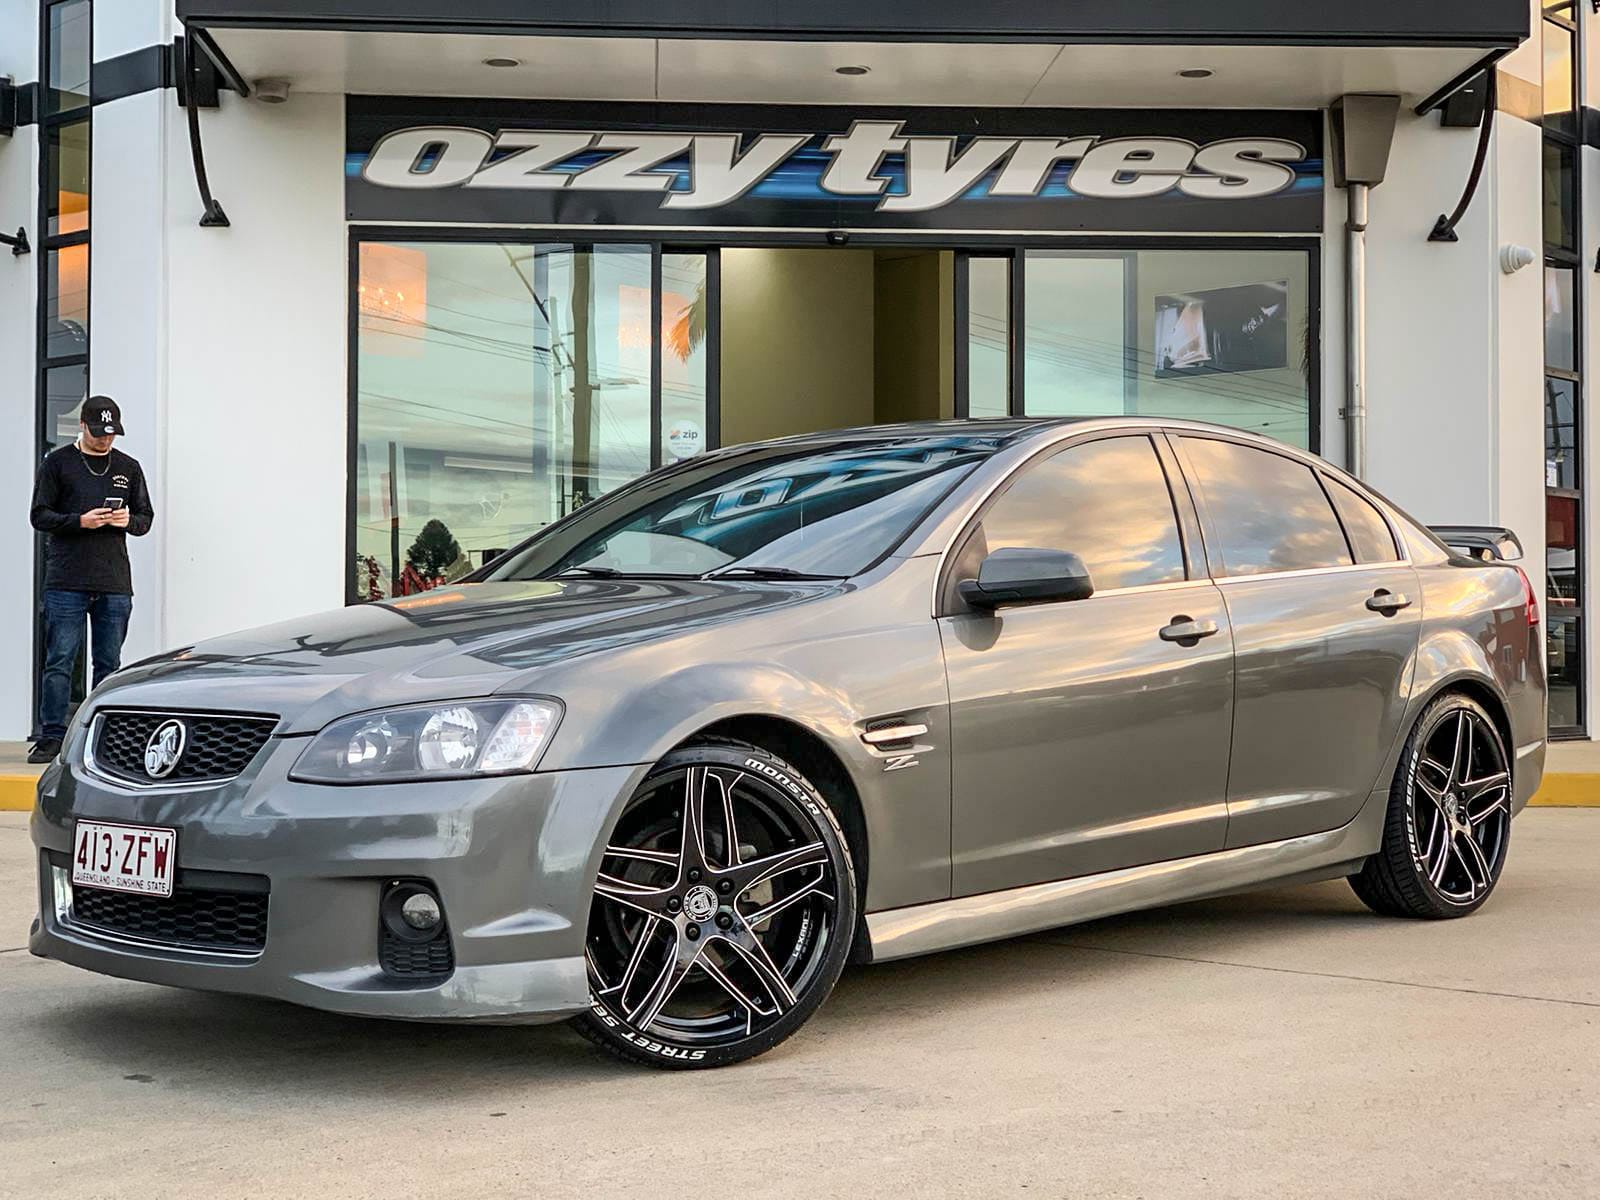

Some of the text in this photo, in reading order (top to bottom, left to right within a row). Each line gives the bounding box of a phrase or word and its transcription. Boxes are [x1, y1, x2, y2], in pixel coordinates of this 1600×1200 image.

[361, 118, 1309, 213] ozzy tyres
[682, 430, 698, 440] zip
[116, 876, 145, 890] SUNSHINE
[147, 880, 167, 893] STATE
[620, 1030, 707, 1061] STREET
